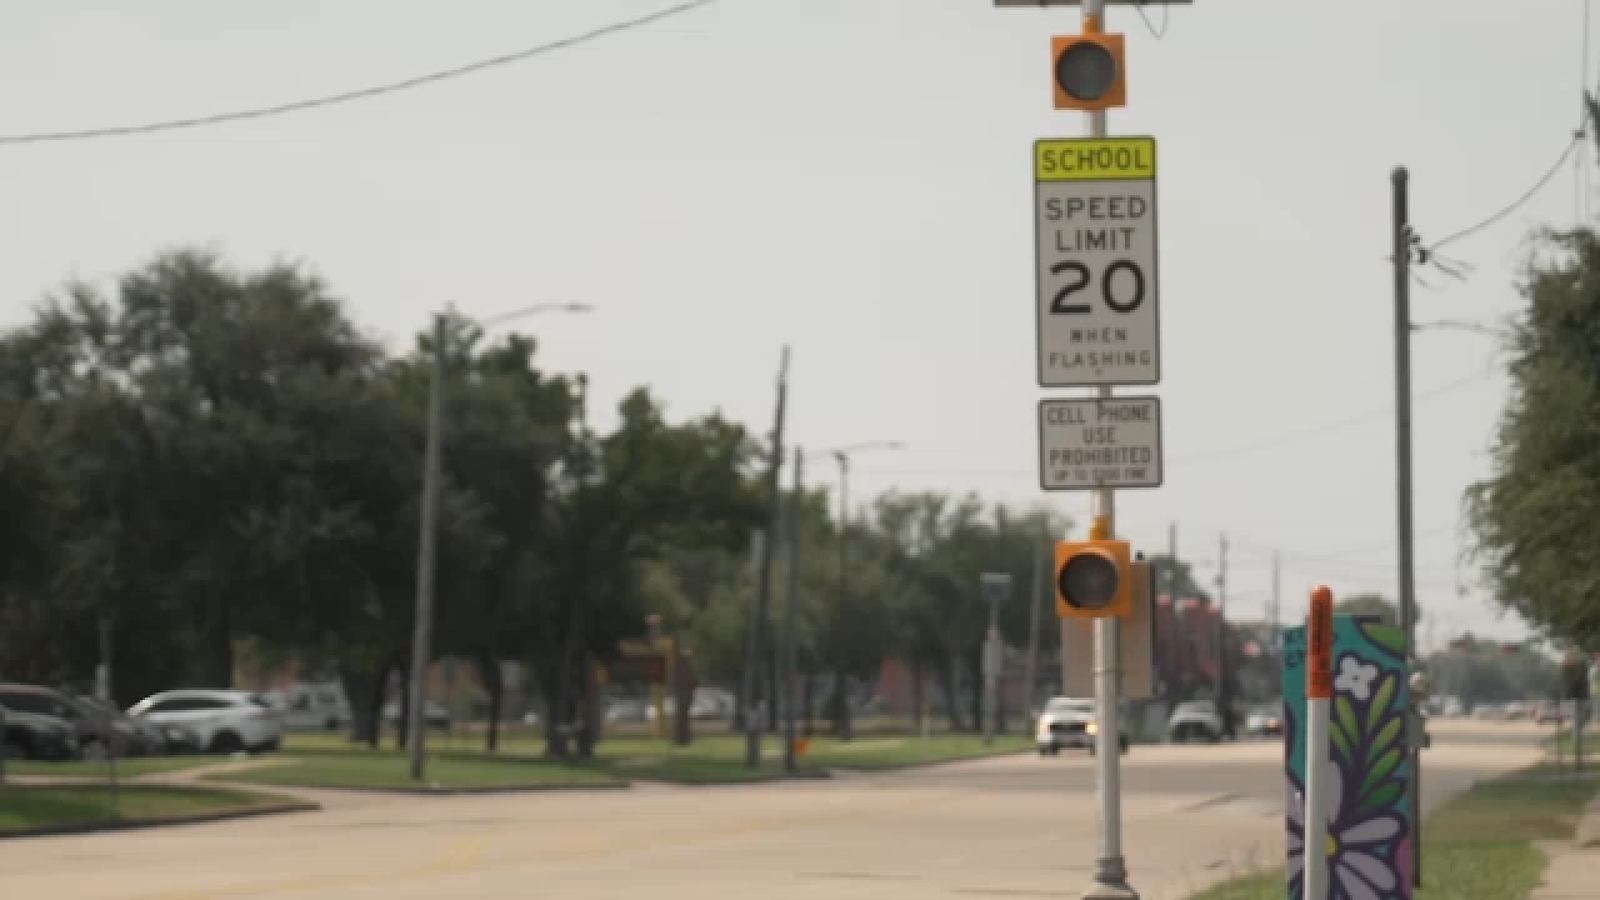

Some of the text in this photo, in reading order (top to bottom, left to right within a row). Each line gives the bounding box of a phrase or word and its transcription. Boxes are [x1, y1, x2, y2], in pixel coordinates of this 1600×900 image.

[1042, 147, 1149, 172] SCHOOL
[1045, 196, 1147, 221] SPEED
[1055, 228, 1136, 252] LIMIT
[1049, 258, 1146, 315] 20
[1070, 327, 1128, 344] WHEN
[1048, 349, 1151, 369] FLASHING
[1047, 403, 1151, 425] CELL PHONE
[1082, 425, 1118, 446] USE
[1049, 445, 1151, 467] PROHIBITED
